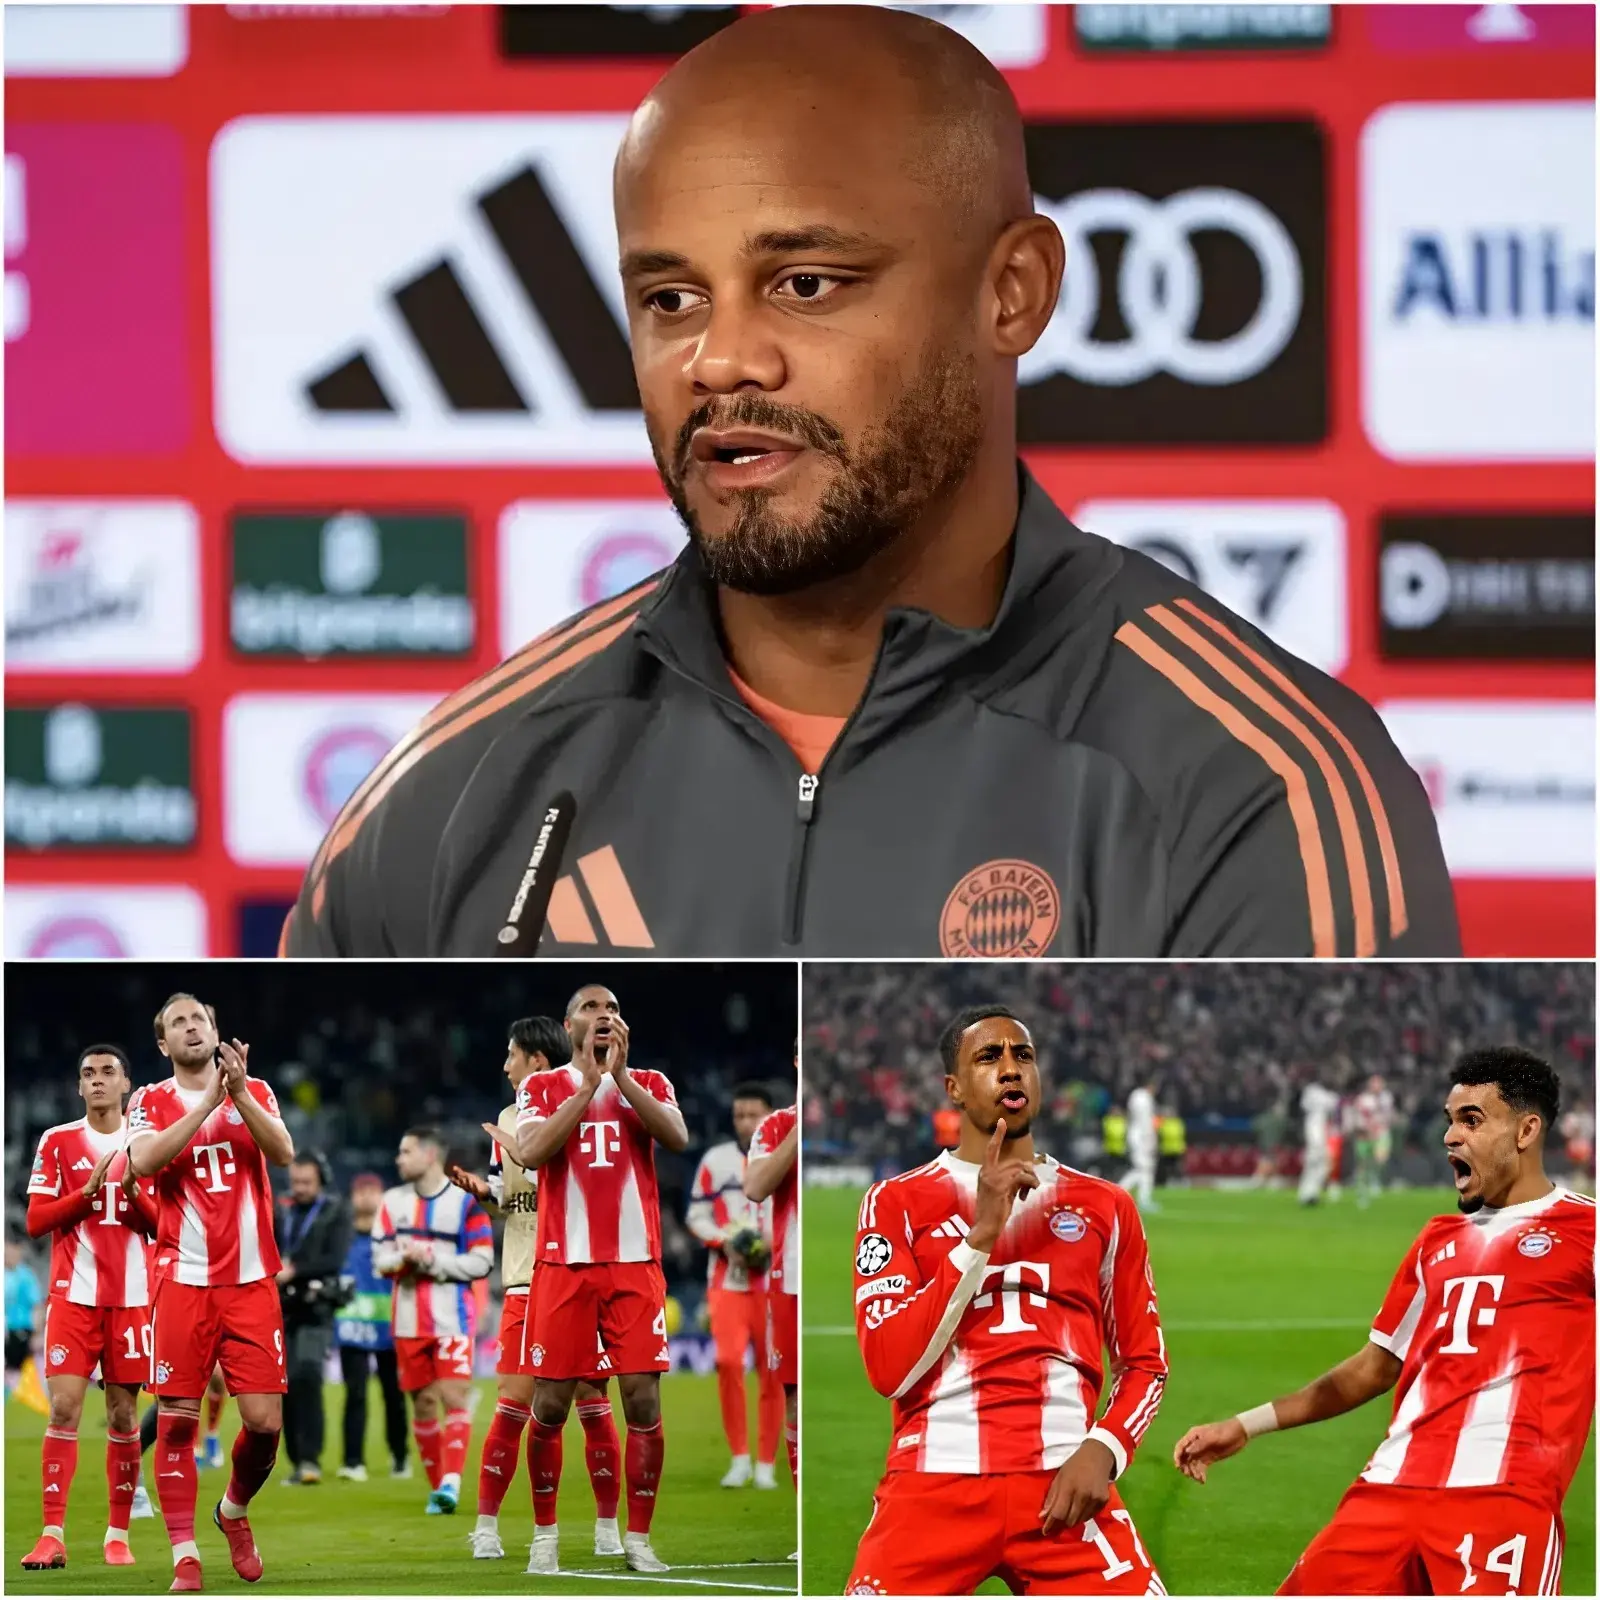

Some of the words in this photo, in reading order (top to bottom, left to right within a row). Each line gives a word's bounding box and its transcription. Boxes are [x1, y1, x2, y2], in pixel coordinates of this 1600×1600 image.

[958, 880, 983, 906] FC
[989, 869, 1051, 919] BAYERN
[193, 1141, 236, 1193] T
[580, 1121, 620, 1168] T
[973, 1261, 1050, 1334] T
[1434, 1274, 1505, 1354] T
[438, 1336, 469, 1361] 22
[653, 1307, 668, 1342] 4
[1082, 1510, 1150, 1581] 17
[1455, 1533, 1527, 1591] 14
